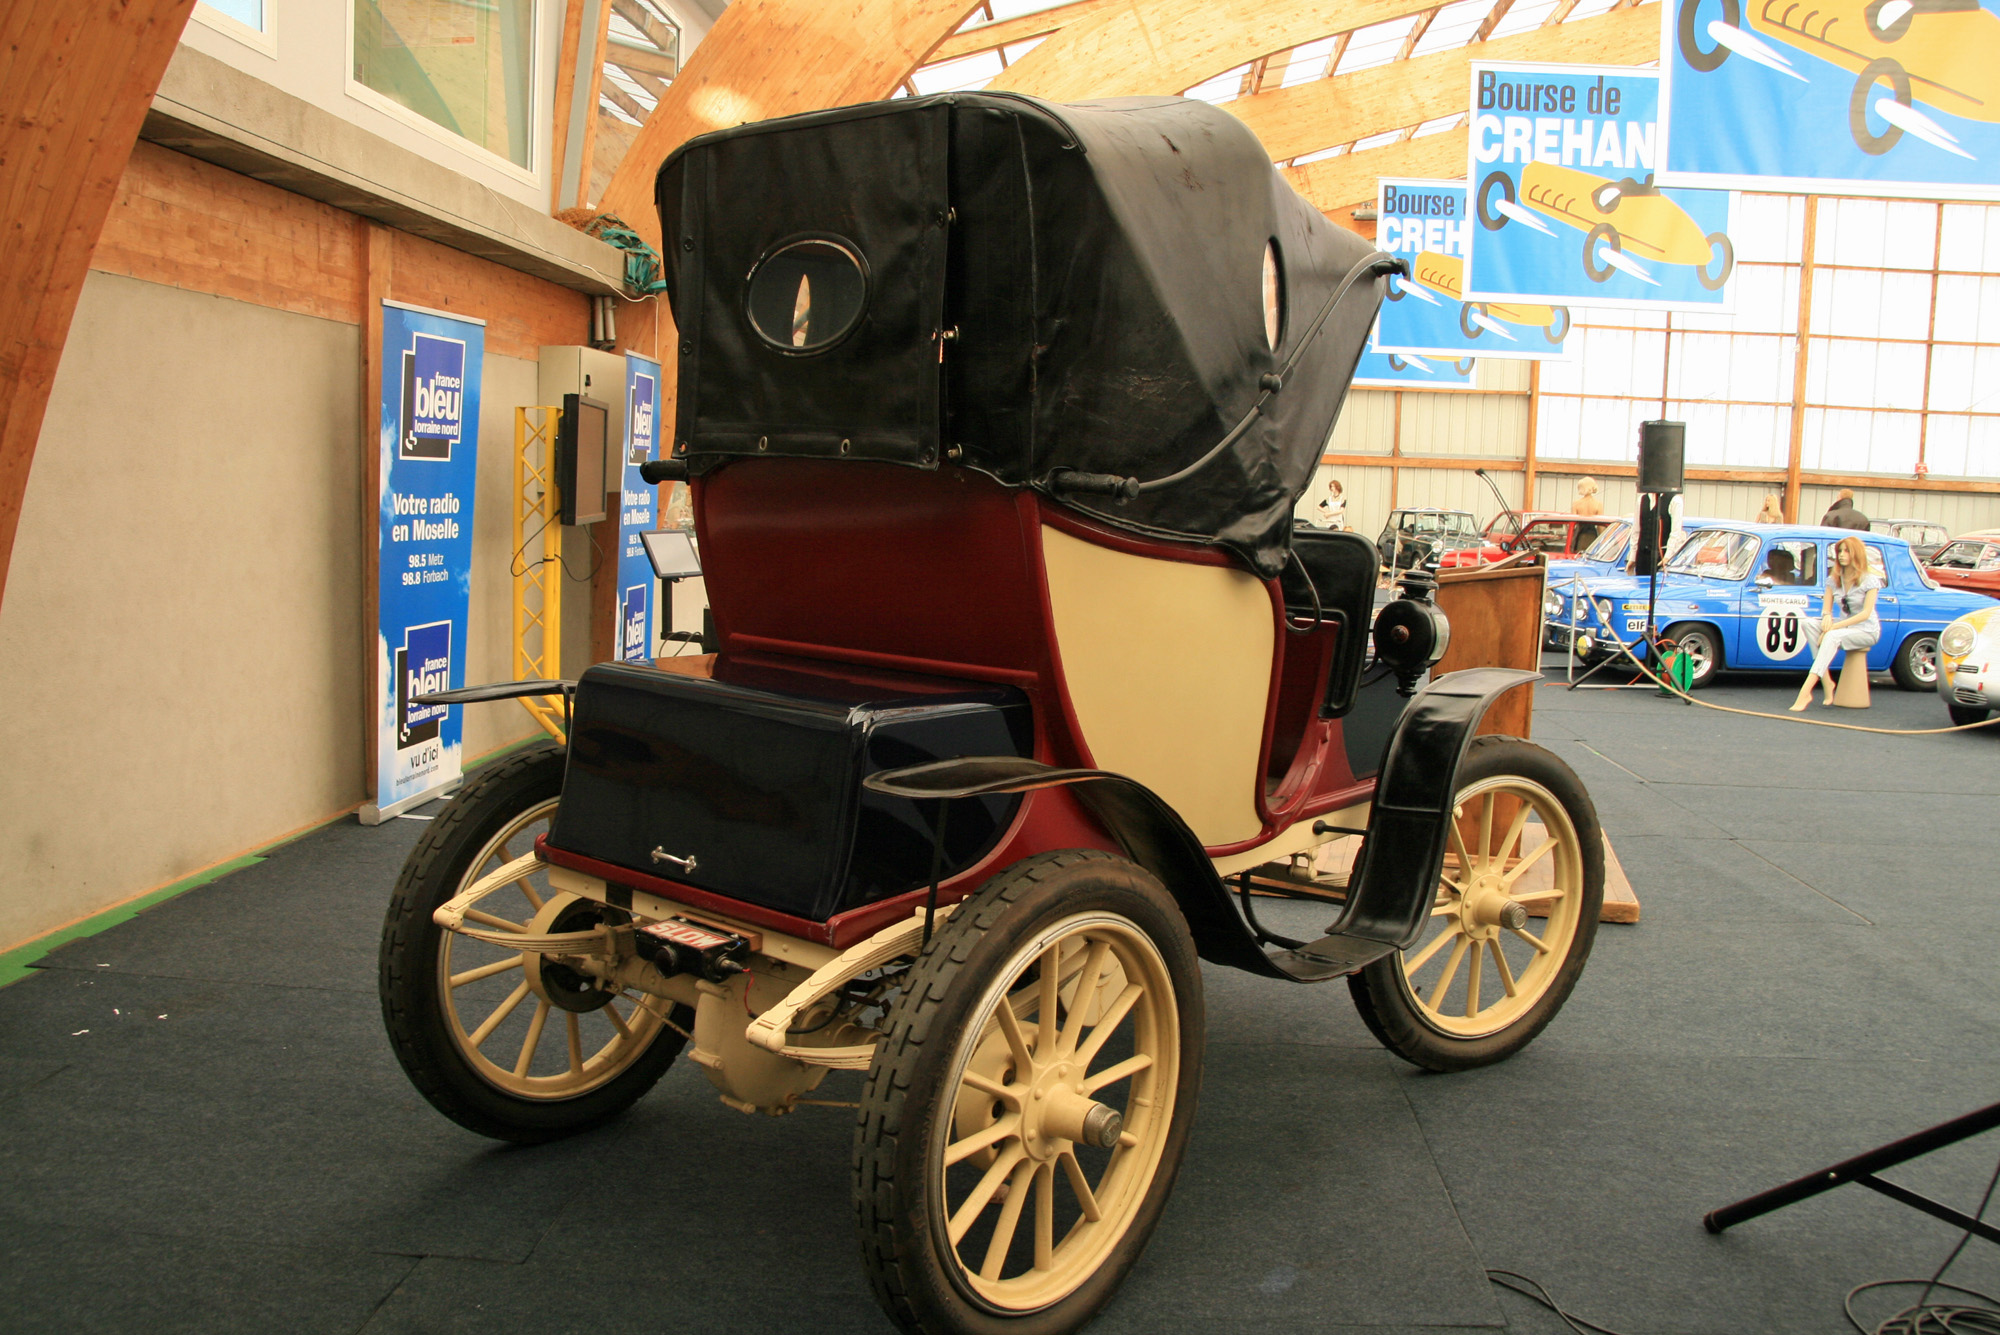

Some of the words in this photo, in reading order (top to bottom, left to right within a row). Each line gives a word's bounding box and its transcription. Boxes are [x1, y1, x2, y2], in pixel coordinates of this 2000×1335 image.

[1478, 70, 1576, 113] Bourse
[1587, 75, 1621, 115] de
[1383, 184, 1455, 216] Bourse
[435, 371, 460, 389] france
[415, 377, 460, 420] bleu
[414, 419, 440, 434] lorraine
[441, 423, 458, 435] nord
[634, 405, 651, 435] bleu
[393, 493, 427, 515] Votre
[430, 493, 460, 514] radio
[392, 524, 409, 542] en
[413, 518, 459, 541] Moselle
[409, 554, 426, 568] 98.5
[428, 553, 444, 566] Metz
[402, 571, 421, 586] 98.8
[423, 569, 449, 583] Forbach
[1760, 597, 1807, 606] MONTE-CARLO
[627, 617, 644, 647] bleu
[1627, 620, 1646, 630] elf
[1766, 611, 1799, 653] 89
[425, 657, 447, 672] france
[407, 706, 431, 724] lorraine
[410, 754, 420, 769] vu
[647, 922, 728, 947] SLOW
